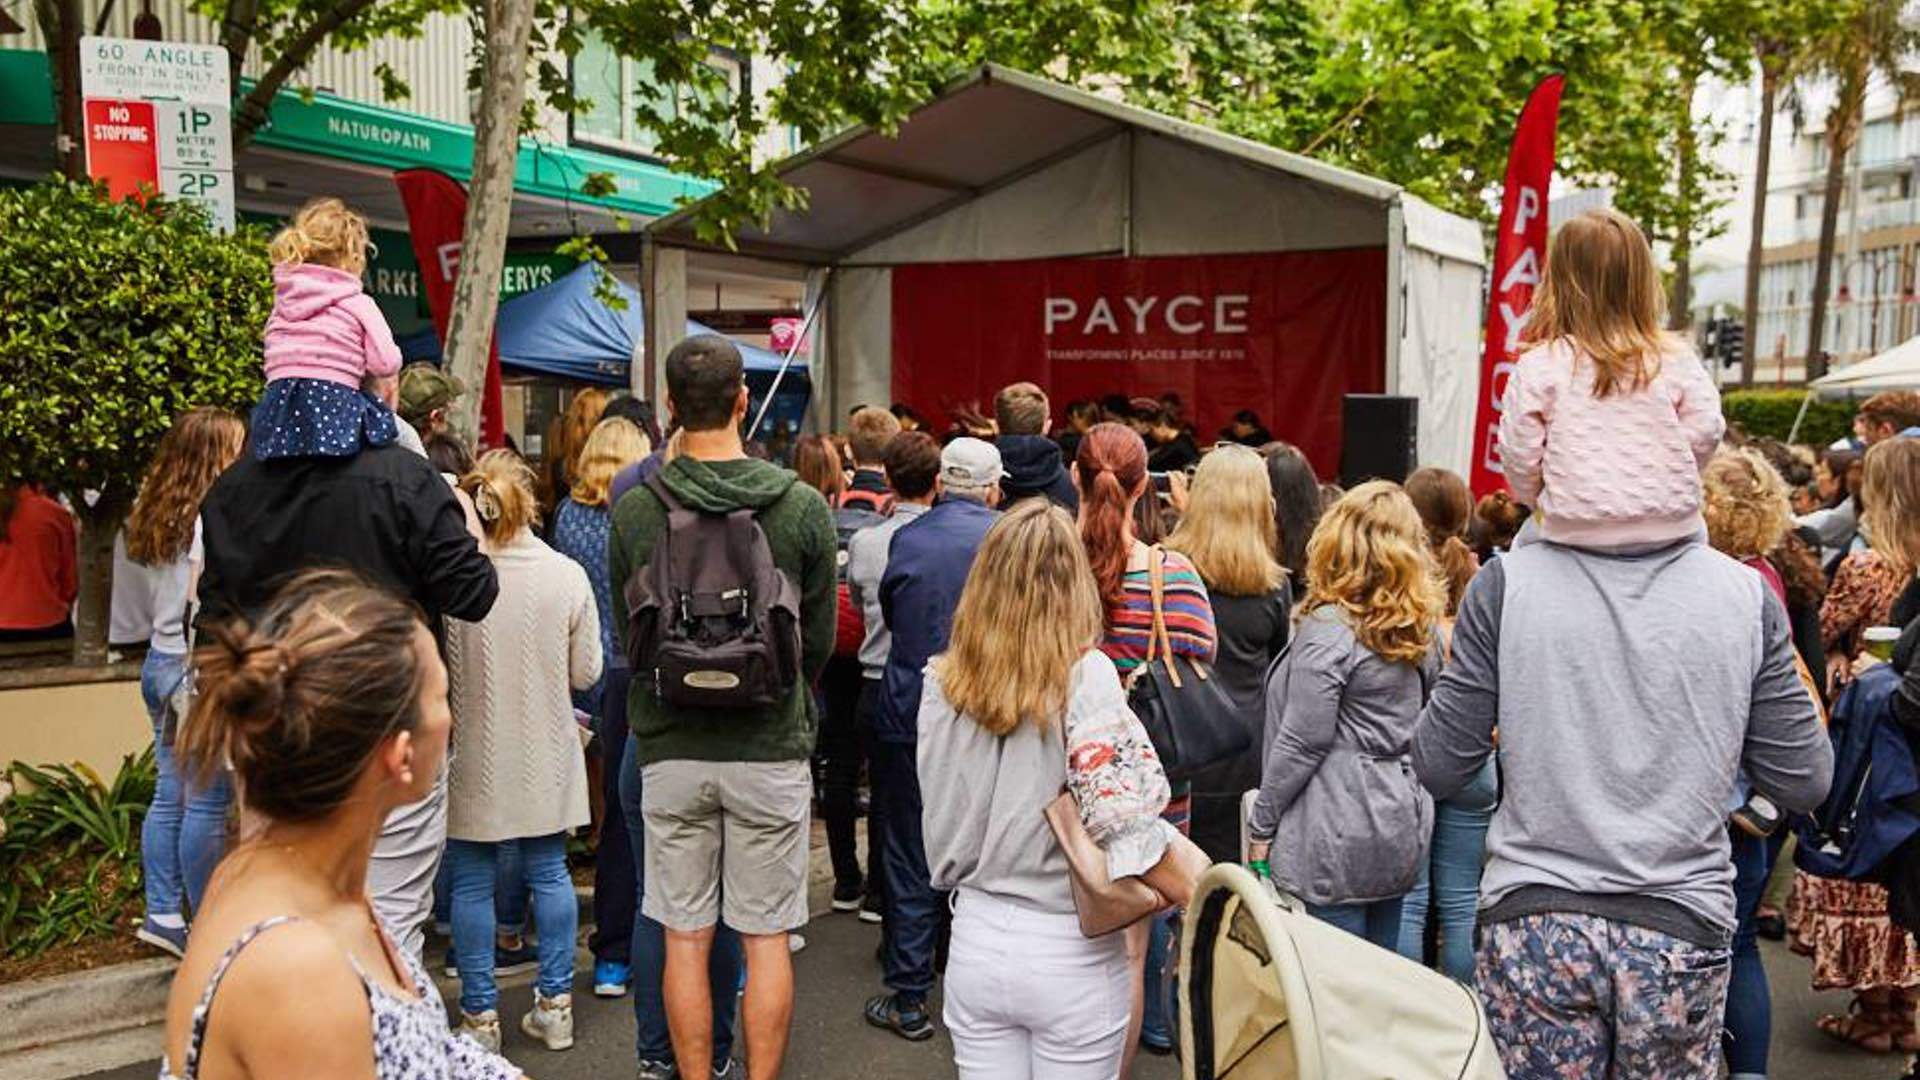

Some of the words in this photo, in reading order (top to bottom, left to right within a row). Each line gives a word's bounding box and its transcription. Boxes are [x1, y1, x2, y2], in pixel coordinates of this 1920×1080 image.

[97, 44, 125, 60] 60
[143, 47, 214, 68] ANGLE
[98, 63, 145, 79] FRONT
[152, 66, 168, 79] IN
[108, 107, 130, 122] NO
[178, 108, 212, 134] 1P
[93, 124, 149, 143] STOPPING
[176, 135, 216, 147] METER
[327, 116, 432, 152] NATUROPATH
[178, 173, 218, 197] 2P
[1044, 295, 1249, 335] PAYCE
